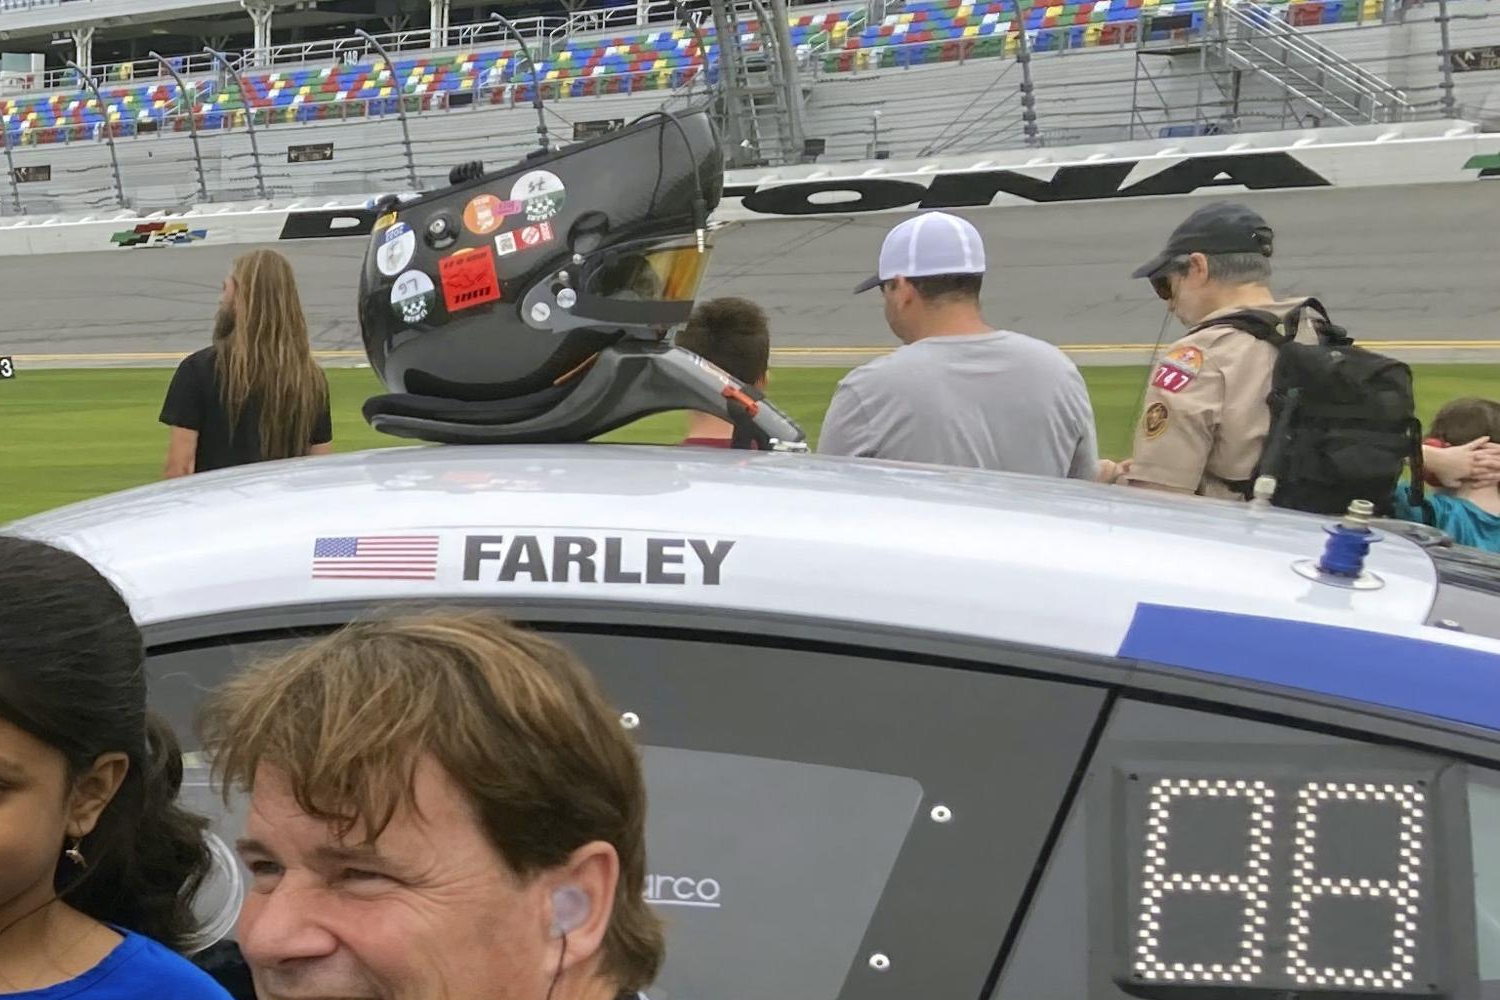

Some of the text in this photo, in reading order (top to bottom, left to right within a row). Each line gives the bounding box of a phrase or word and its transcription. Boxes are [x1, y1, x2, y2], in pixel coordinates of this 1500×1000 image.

[0, 358, 13, 378] 3
[1155, 366, 1190, 391] 747
[463, 535, 737, 586] FARLEY
[1134, 778, 1425, 989] 88
